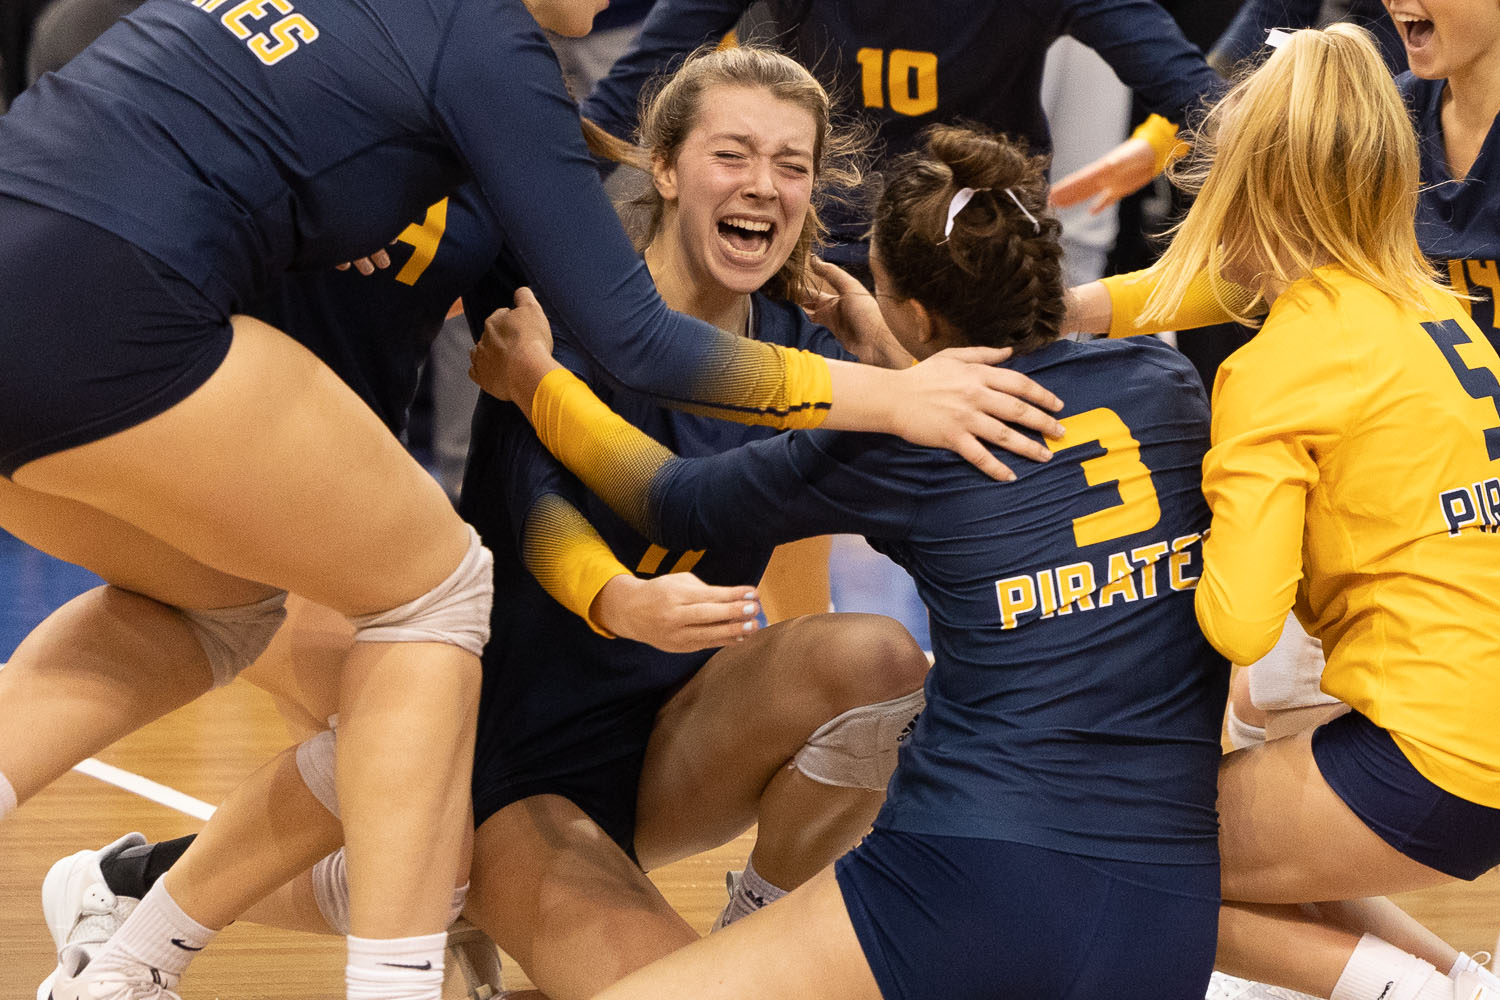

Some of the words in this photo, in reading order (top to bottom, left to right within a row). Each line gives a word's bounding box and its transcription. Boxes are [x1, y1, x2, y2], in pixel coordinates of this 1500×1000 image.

[857, 47, 938, 116] 10
[1042, 407, 1161, 547] 3
[995, 528, 1212, 630] PIRATE
